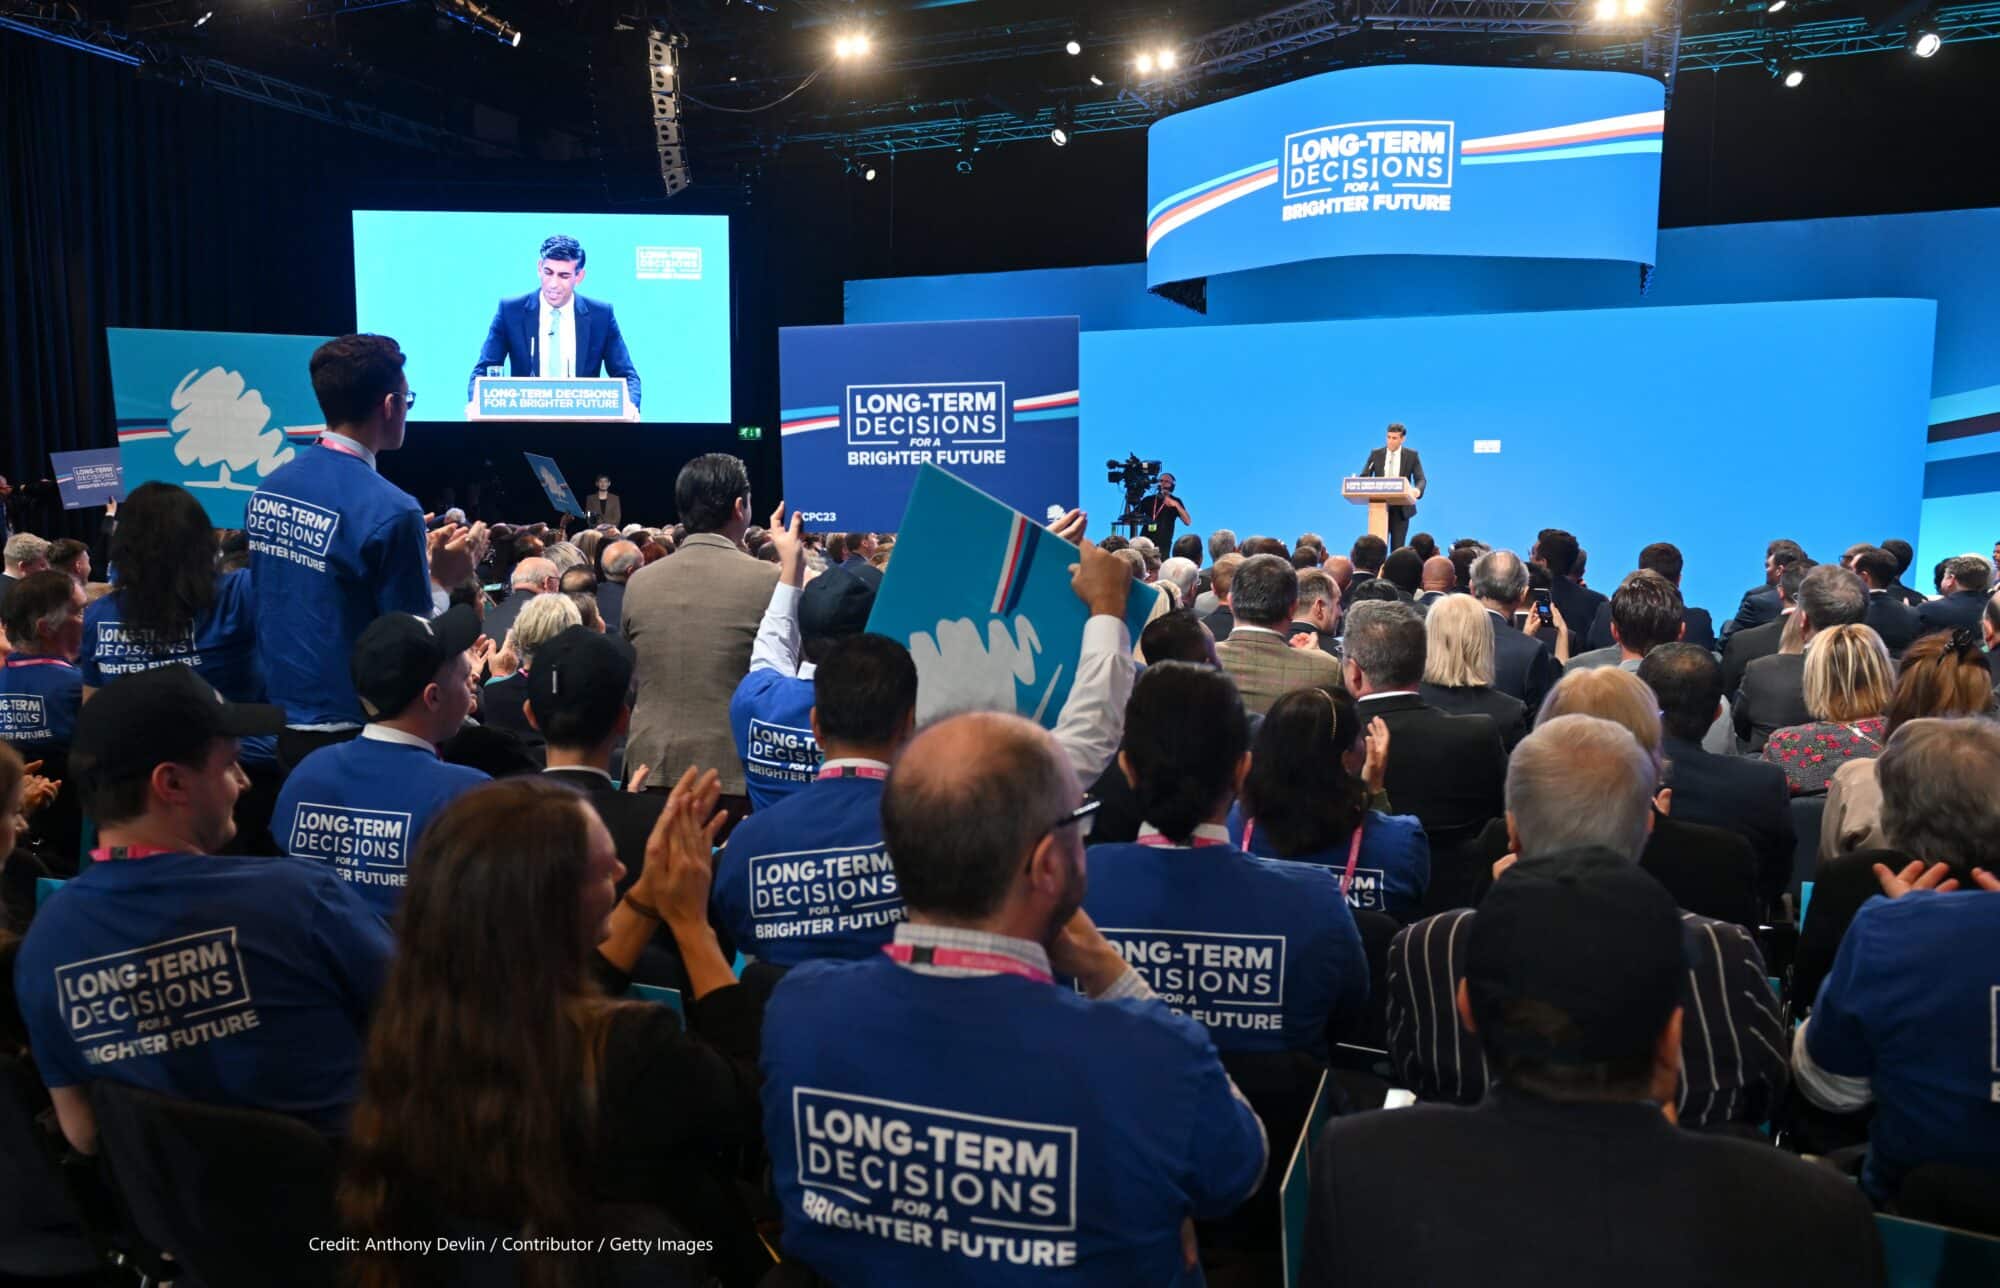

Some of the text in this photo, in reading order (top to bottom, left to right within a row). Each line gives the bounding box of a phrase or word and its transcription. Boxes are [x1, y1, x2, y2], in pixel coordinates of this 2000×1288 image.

[1291, 131, 1446, 166] LONG-TERM
[1290, 156, 1443, 189] DECISIONS
[1343, 180, 1380, 193] FOR A
[1282, 194, 1452, 222] BRIGHTER FUTURE
[484, 388, 619, 399] LONG-TERM DECISIONS
[484, 399, 619, 408] FOR A BRIGHTER FUTURE
[856, 391, 996, 414] LONG-TERM
[856, 414, 996, 436] DECISIONS
[910, 438, 942, 448] FOR A
[848, 450, 1006, 465] BRIGHTER FUTURE
[802, 512, 837, 522] CPC23
[249, 514, 324, 548] DECISIONS
[248, 540, 326, 573] RIGHTER FUTURE
[298, 812, 402, 839] LONG-TERM
[296, 832, 400, 860] DECISIONS
[336, 856, 359, 866] FOR A
[756, 852, 894, 886] LONG-TERM
[354, 870, 408, 887] FUTURE
[756, 874, 897, 908] DECISIONS
[808, 904, 840, 916] FOR A
[755, 918, 834, 939] BRIGHTER
[64, 941, 228, 1002] LONG-TERM
[70, 970, 234, 1030] DECISIONS
[1186, 994, 1197, 1006] A
[137, 1016, 172, 1033] FOR A
[171, 1010, 260, 1049] FUTURE
[1192, 1008, 1283, 1030] FUTURE
[806, 1104, 1058, 1178] LONG-TERM
[808, 1142, 1058, 1217] DECISIONS
[892, 1198, 948, 1222] FOR A
[802, 1188, 1078, 1268] BRIGHTER FUTURE
